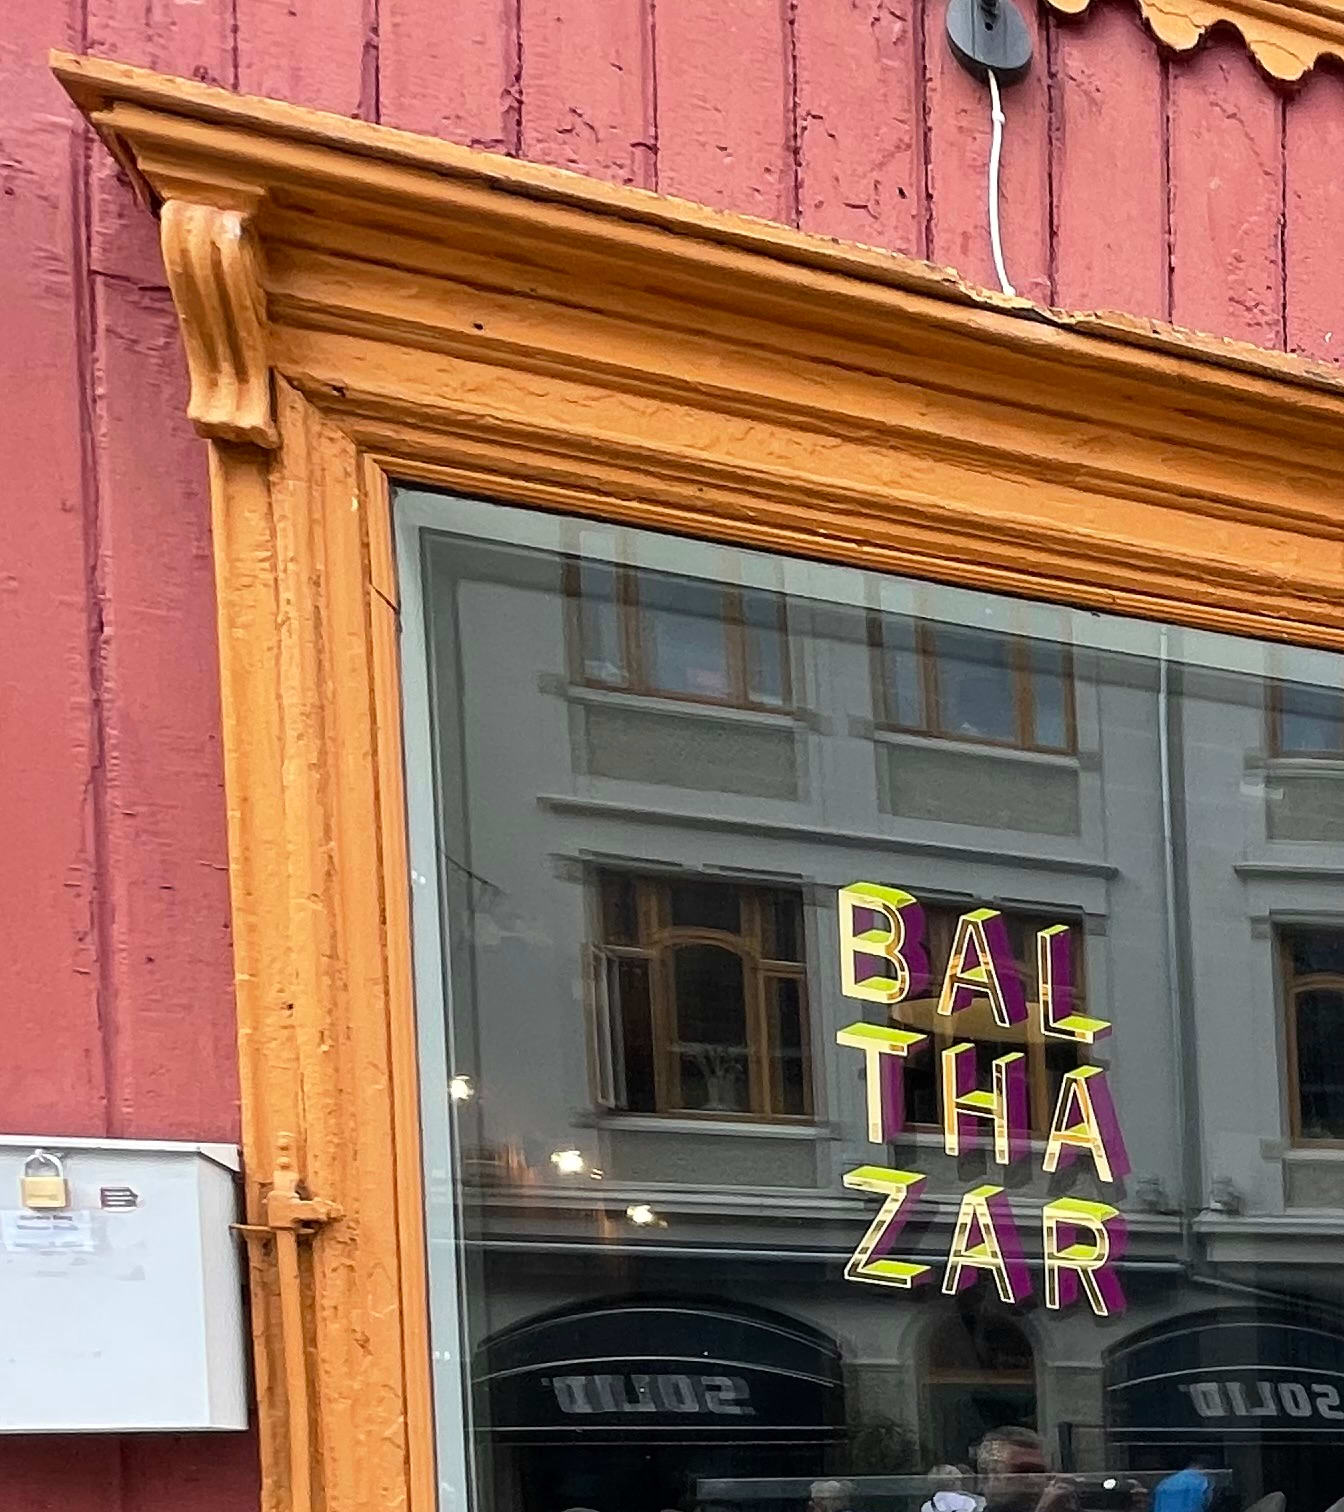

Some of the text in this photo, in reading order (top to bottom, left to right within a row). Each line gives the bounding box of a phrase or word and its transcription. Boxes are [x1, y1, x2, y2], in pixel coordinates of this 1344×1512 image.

[838, 881, 1113, 1044] BAL
[836, 1023, 1132, 1184] THA
[842, 1165, 1130, 1318] ZAR
